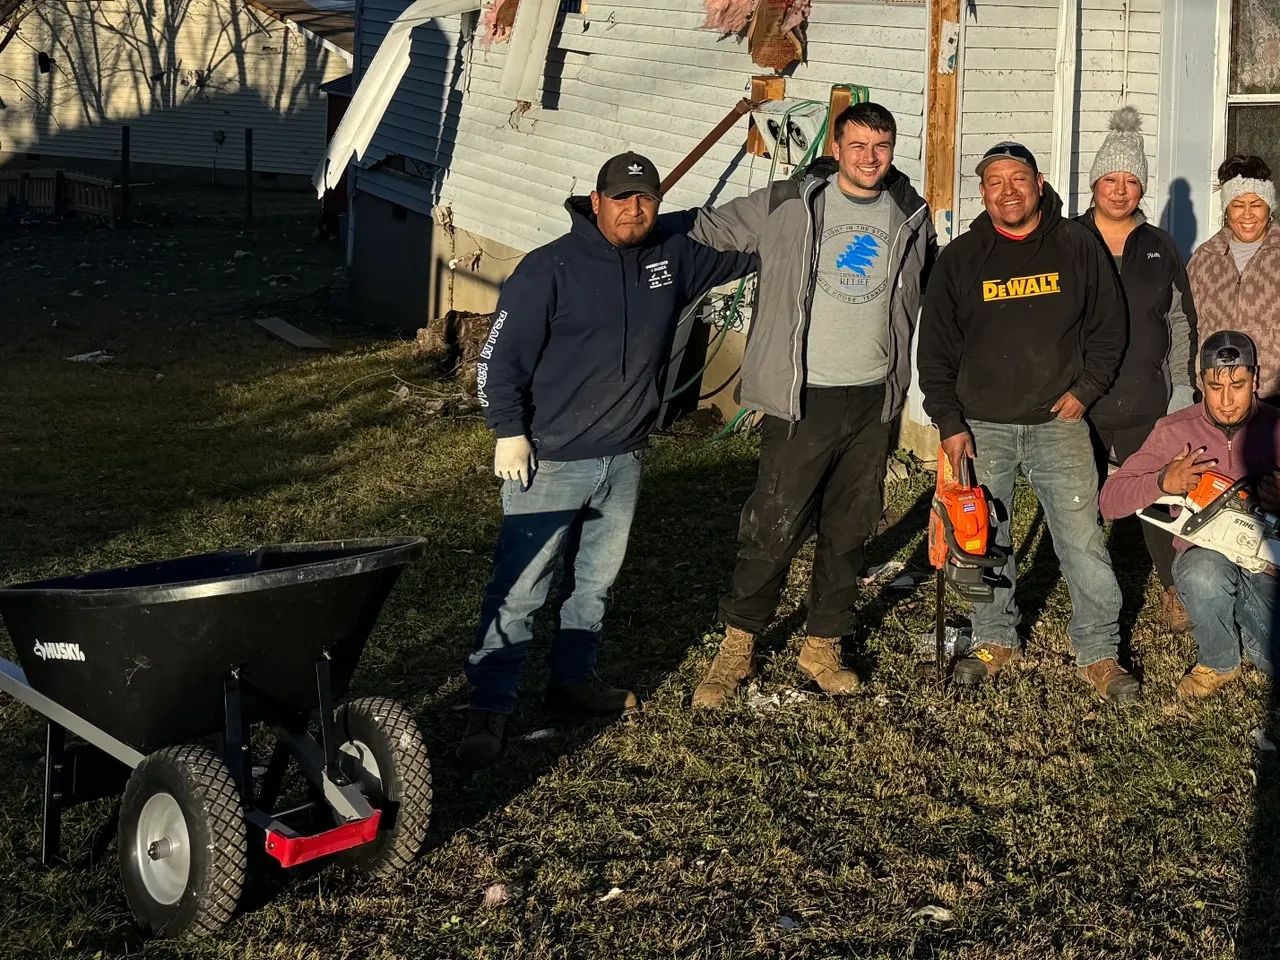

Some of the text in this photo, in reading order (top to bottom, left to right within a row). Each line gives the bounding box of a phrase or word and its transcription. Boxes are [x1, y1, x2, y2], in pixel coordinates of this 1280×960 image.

[871, 228, 890, 241] STOR
[840, 278, 871, 286] RELIEF
[480, 309, 508, 360] PSALM
[1233, 518, 1255, 531] STIHL
[43, 642, 81, 661] HUSKY
